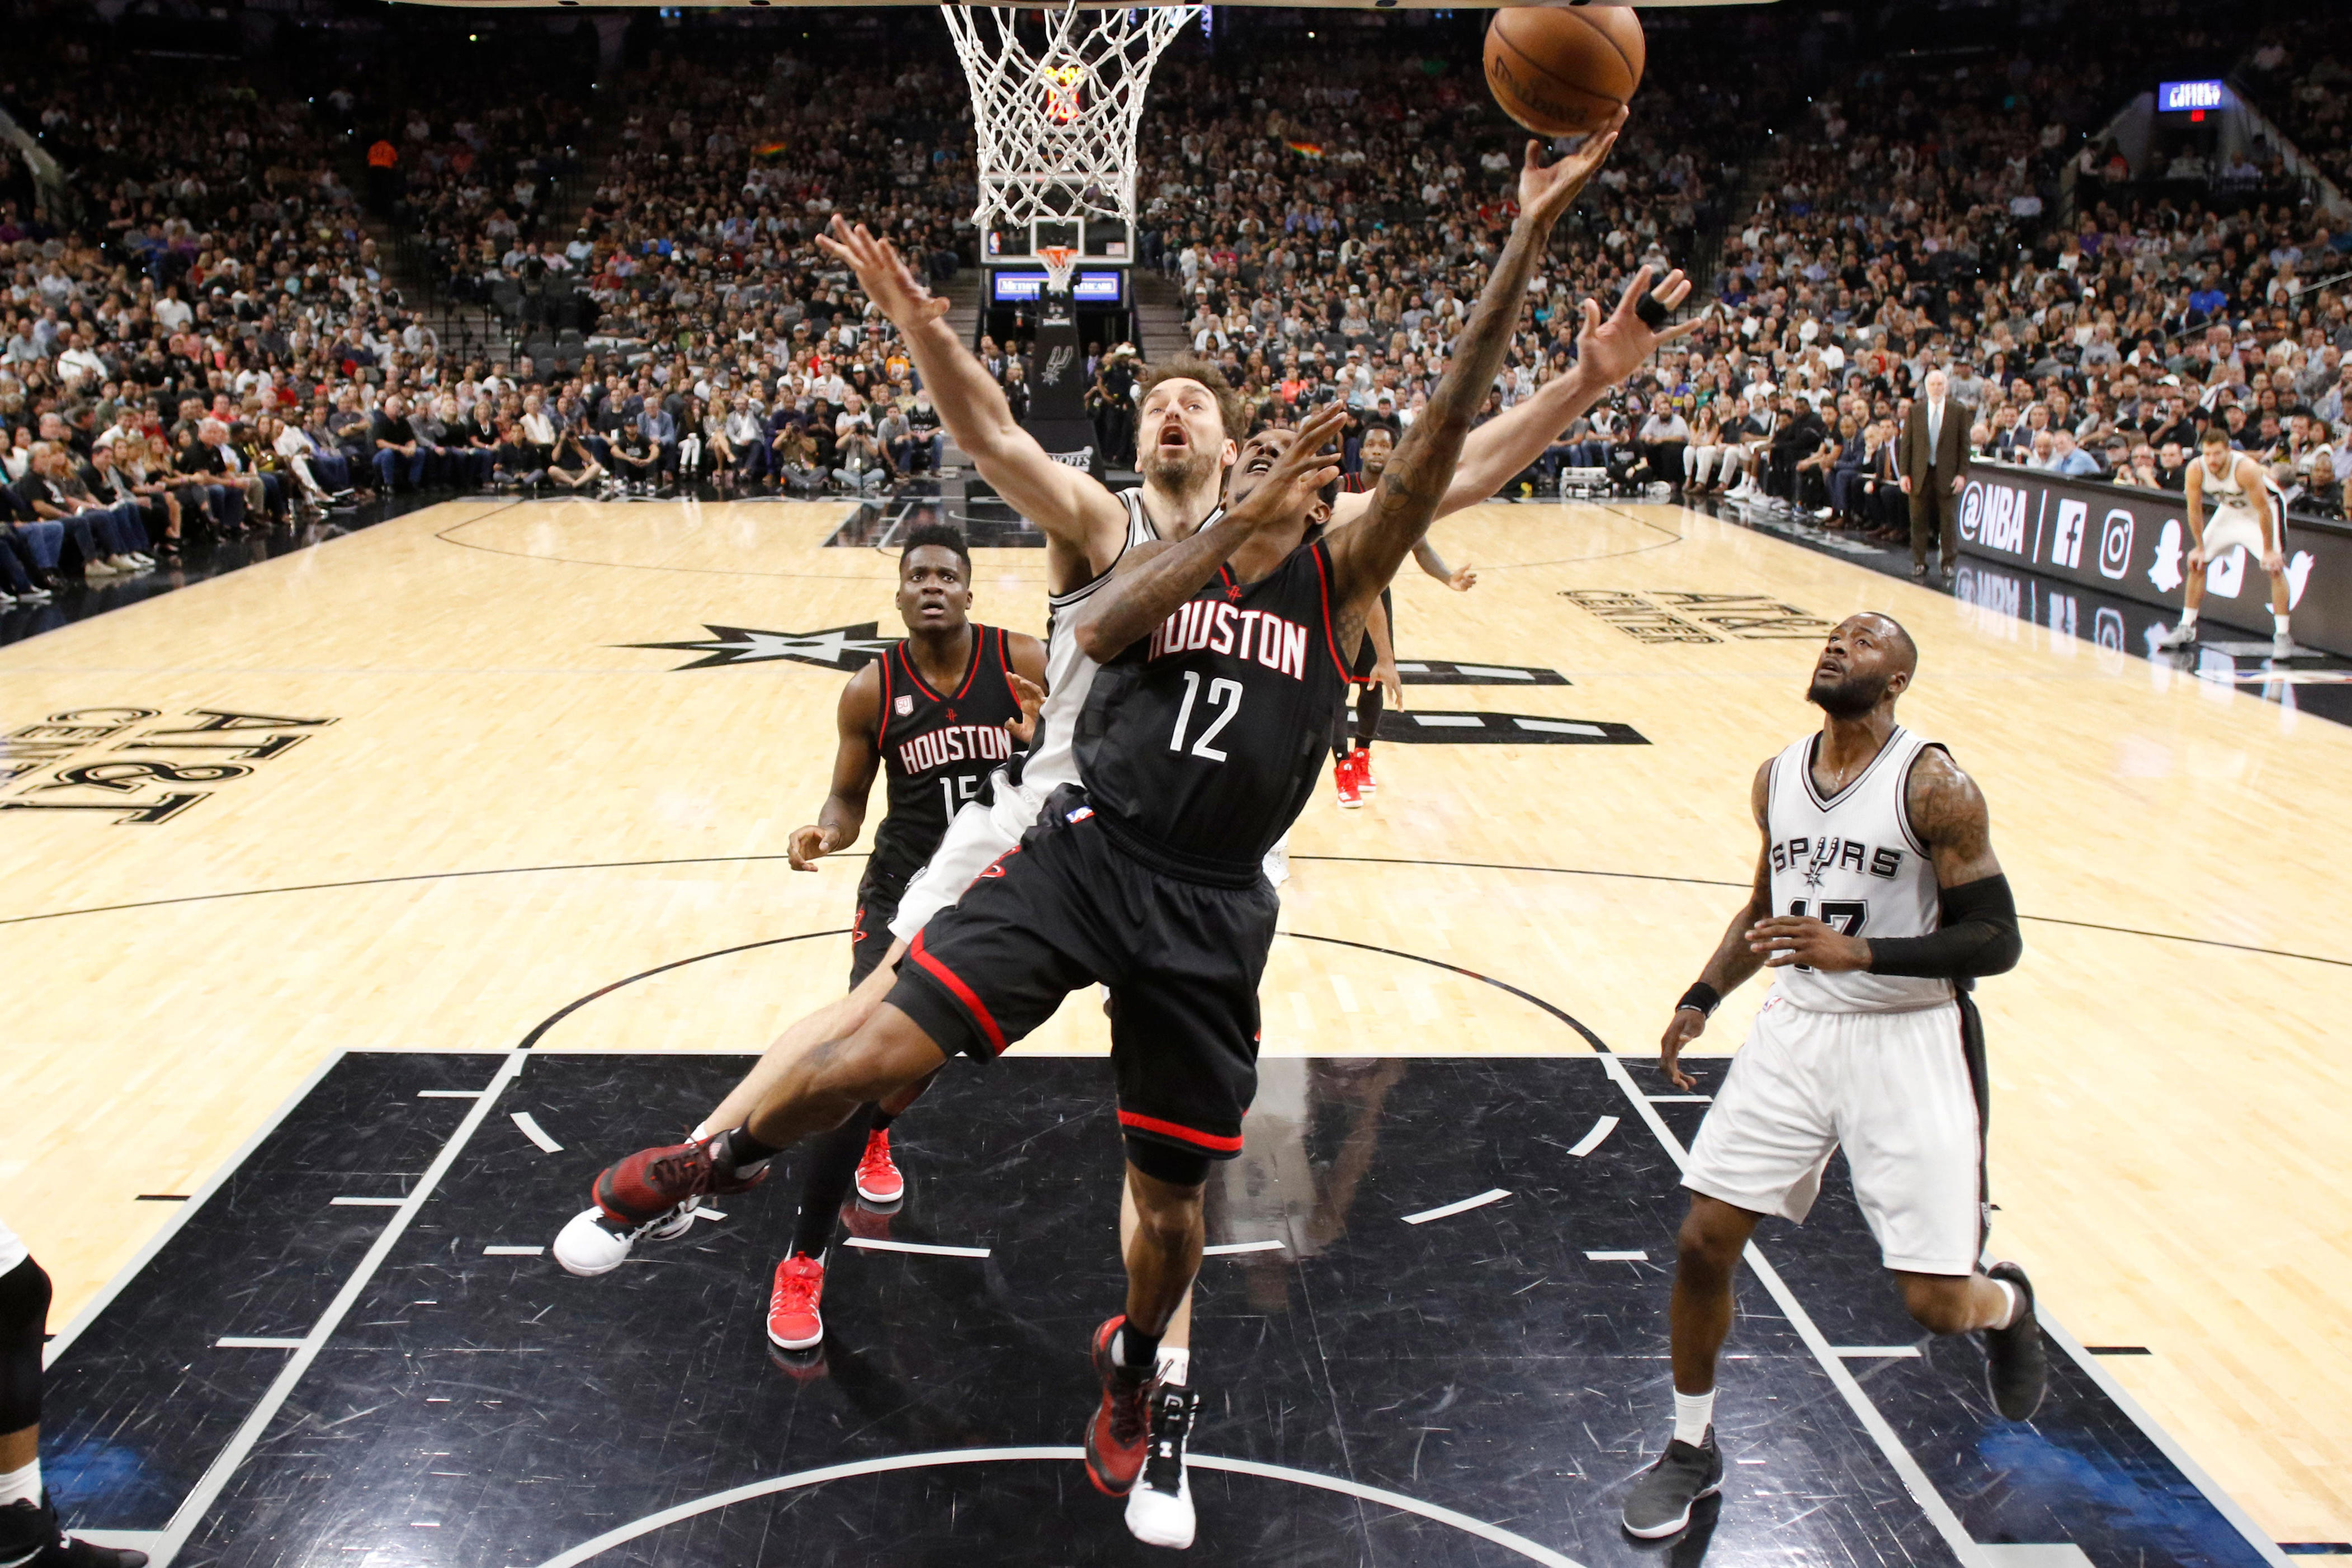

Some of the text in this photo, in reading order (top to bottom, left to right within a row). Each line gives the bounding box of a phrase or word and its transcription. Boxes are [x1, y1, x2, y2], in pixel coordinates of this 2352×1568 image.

[1959, 480, 2028, 555] @NBA
[1170, 671, 1243, 762] 12
[899, 725, 1012, 775] HOUSTON
[1770, 837, 1904, 891] SPURS
